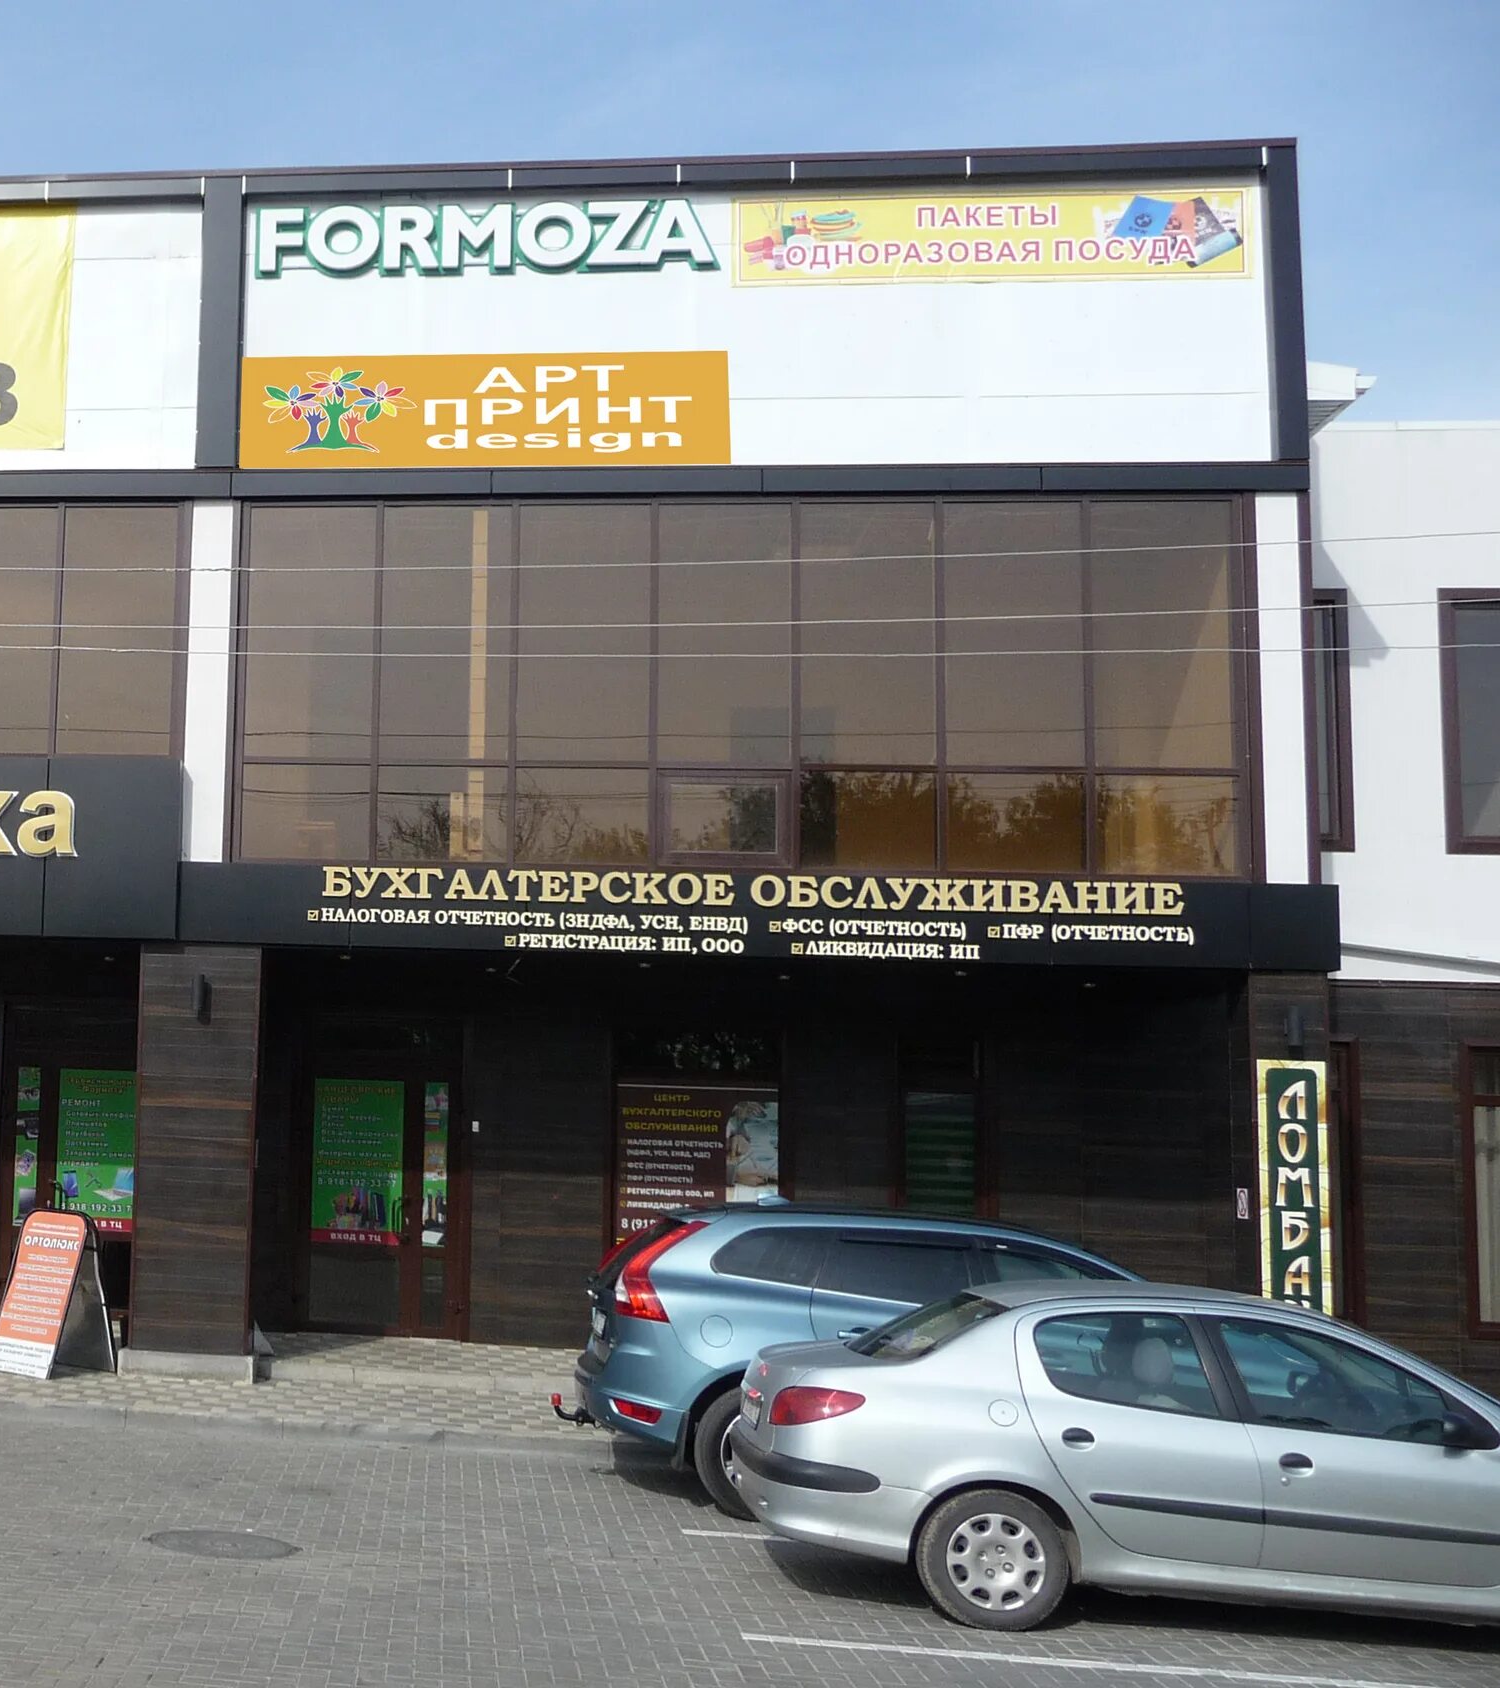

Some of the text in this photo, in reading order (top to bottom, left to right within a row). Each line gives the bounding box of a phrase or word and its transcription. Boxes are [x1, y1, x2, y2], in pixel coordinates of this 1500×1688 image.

[917, 204, 1057, 228] ПАКЕТЫ
[255, 199, 720, 279] FORMOZA
[785, 236, 1197, 269] ОДНОРАЗОВАЯ ПОСУДА
[473, 364, 625, 394] АРТ
[423, 396, 692, 425] ПРИНТ
[426, 427, 682, 453] design
[322, 866, 1185, 915] БУХГАЛТЕРСКОЕ ОБСЛУЖИВАНИЕ
[321, 908, 430, 925] НАЛОГОВАЯ
[434, 909, 555, 928] ОТЧЕТНОСТЬ
[639, 914, 684, 933] УСН,
[689, 916, 749, 935] ЕНВД)
[782, 918, 967, 941] ФСС (ОТЧЕТНОСТЬ)
[518, 933, 745, 955] РЕГИСТРАЦИЯ: ИП, ООО
[1002, 922, 1195, 946] ПФР (ОТЧЕТНОСТЬ)
[805, 941, 980, 960] ЛИКВИДАЦИЯ: ИП
[61, 1099, 100, 1107] РЕМОНТ
[654, 1094, 690, 1102] ЦЕНТР
[622, 1107, 722, 1118] БУХГАЛТЕРСКОГО
[625, 1123, 719, 1133] ОБСЛУЖИВАНИЯ
[627, 1139, 724, 1149] НАЛОГОВАЯ ОТЧЕТНОСТЬ
[1275, 1080, 1315, 1308] ЛОМБА
[621, 1218, 628, 1229] 8
[24, 1235, 80, 1250] ОРТОЛЮКС
